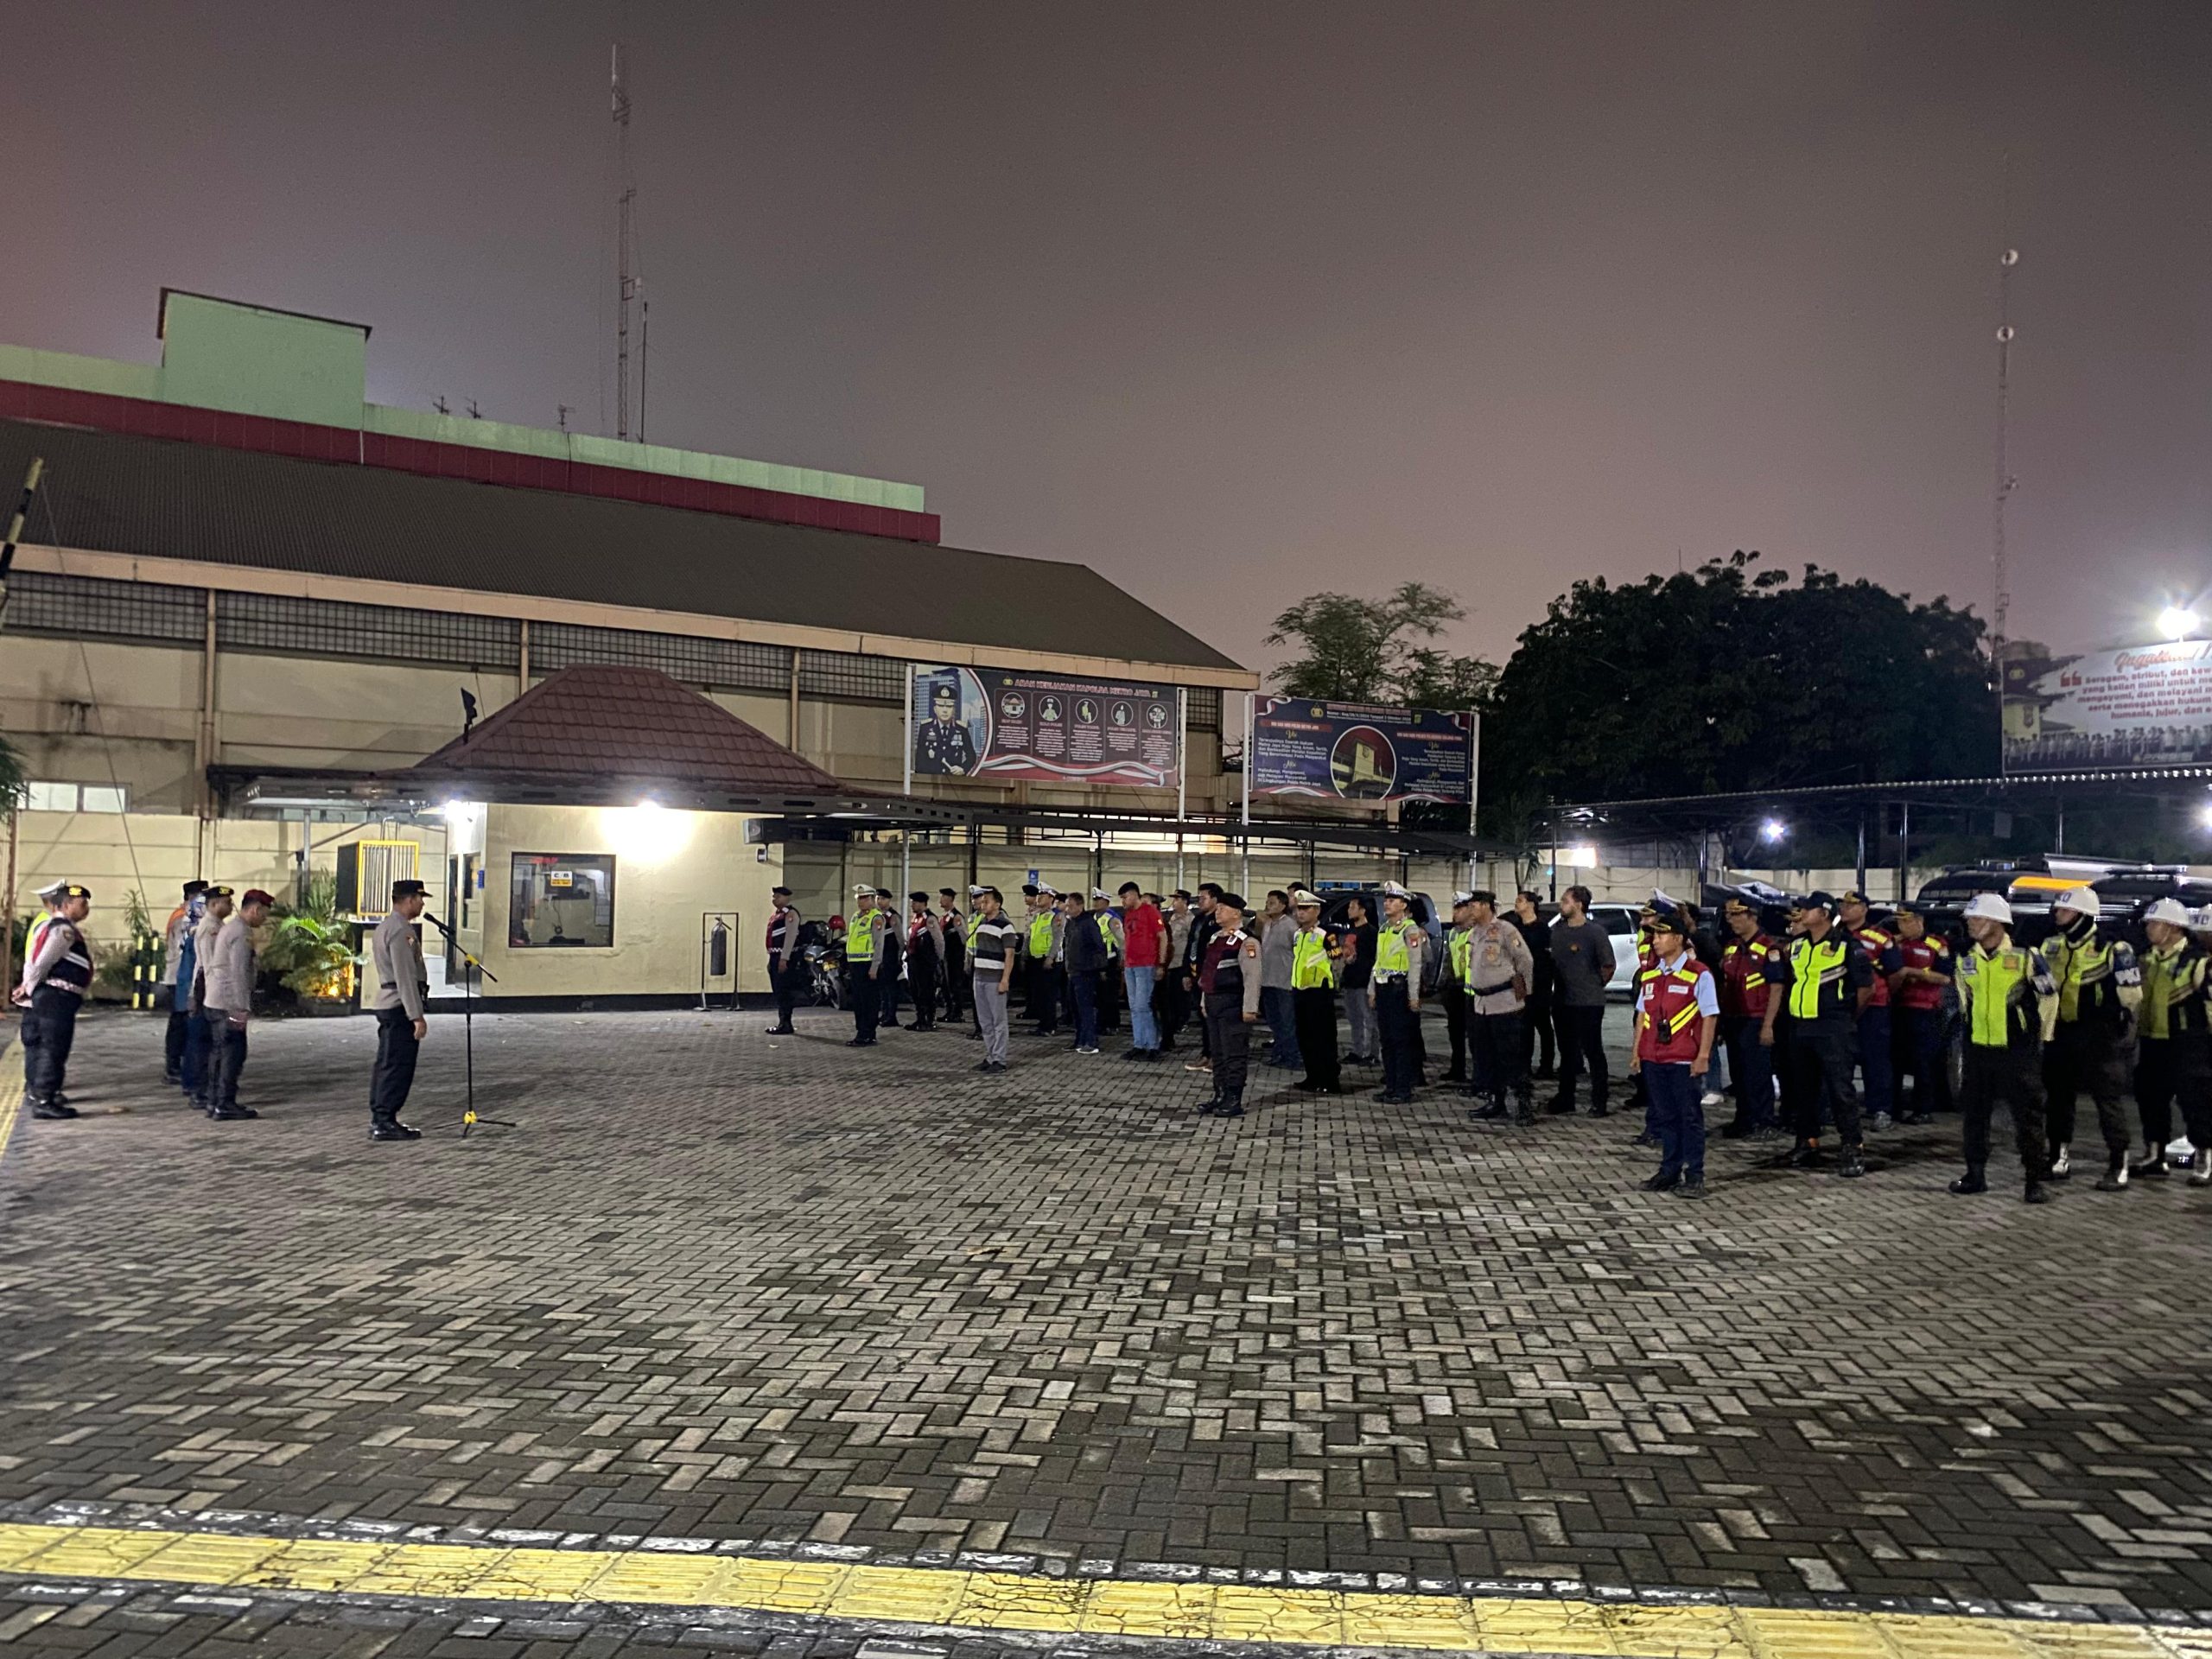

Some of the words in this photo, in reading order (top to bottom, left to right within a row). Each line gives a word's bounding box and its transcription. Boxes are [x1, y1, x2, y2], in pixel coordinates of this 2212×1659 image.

[2132, 671, 2167, 679] atribut,
[2082, 685, 2105, 694] yang
[2107, 683, 2135, 691] kalian
[2138, 679, 2164, 689] miliki
[2167, 677, 2196, 686] untuk
[2077, 692, 2134, 703] mengayomi,
[2158, 686, 2202, 696] melayani
[2088, 703, 2112, 712] serta
[2114, 699, 2175, 709] menegakkan
[2177, 696, 2212, 705] hukum
[2111, 709, 2154, 719] humanis,
[2156, 708, 2182, 717] jujur,
[2183, 706, 2202, 715] dan
